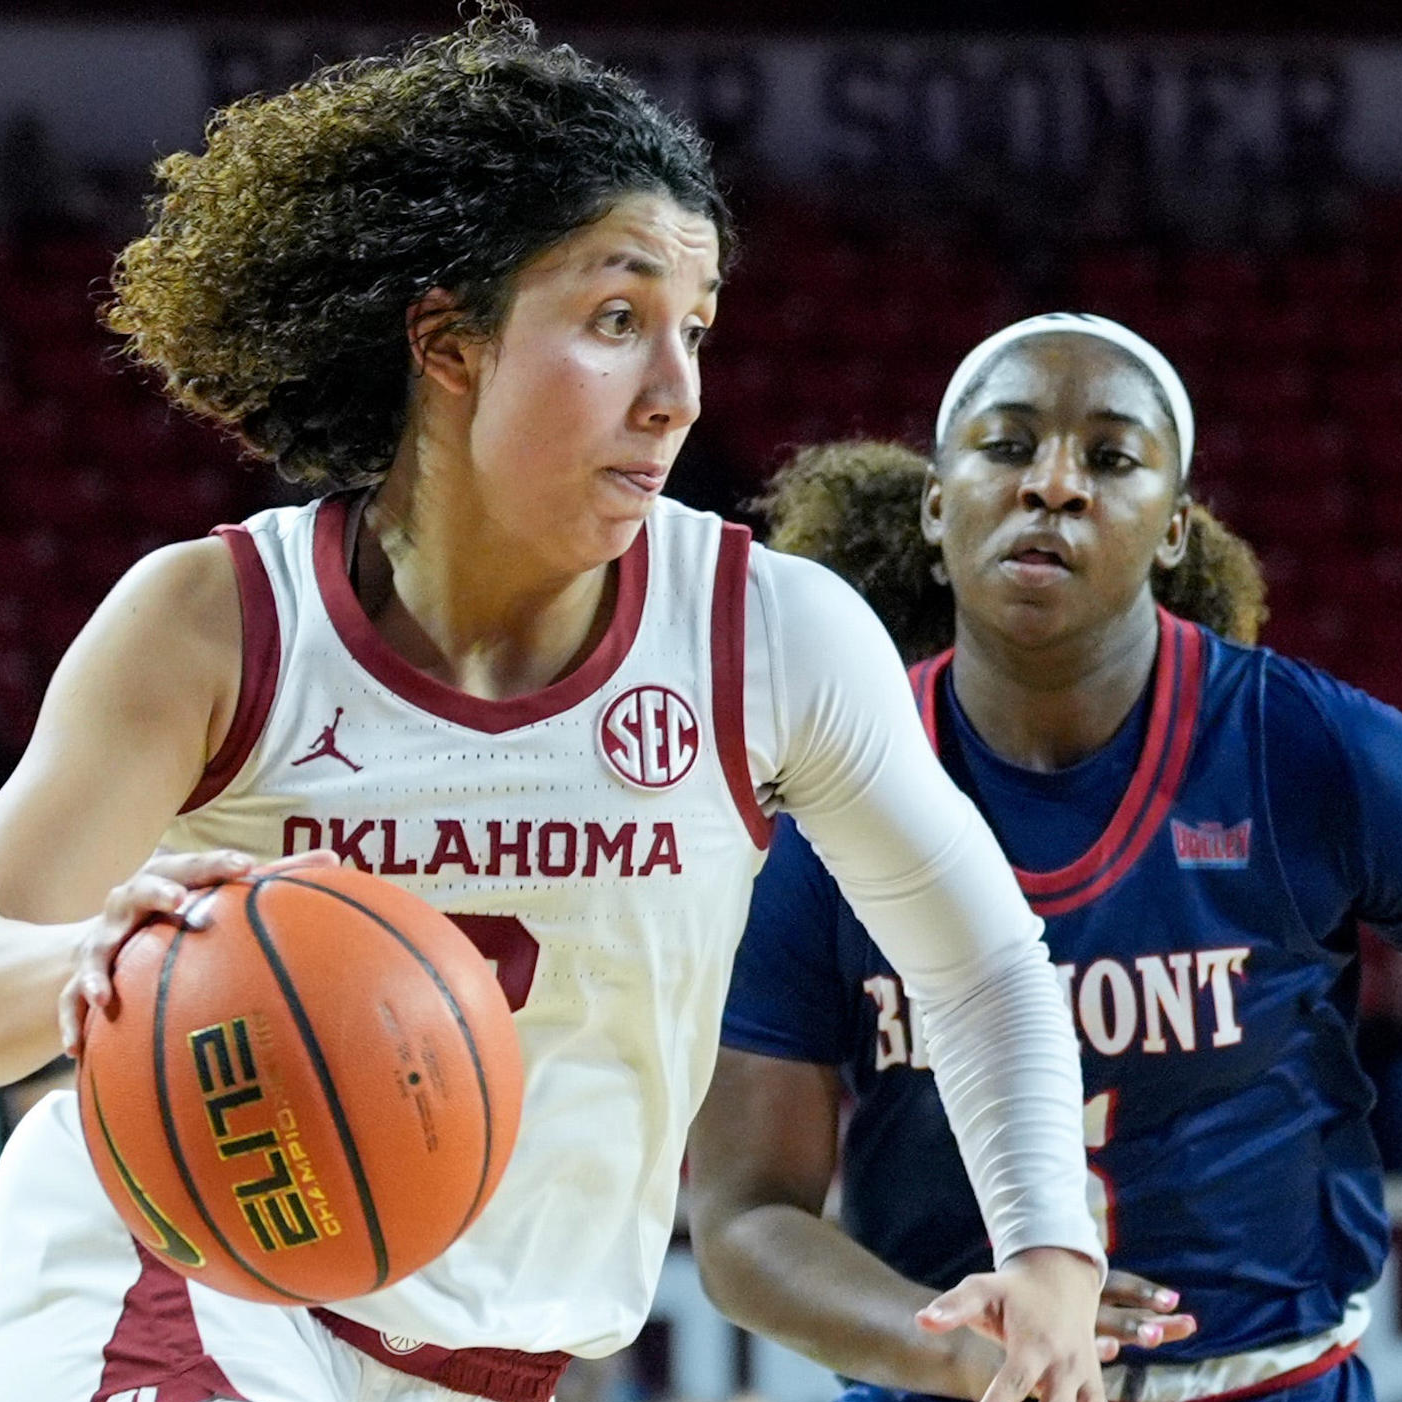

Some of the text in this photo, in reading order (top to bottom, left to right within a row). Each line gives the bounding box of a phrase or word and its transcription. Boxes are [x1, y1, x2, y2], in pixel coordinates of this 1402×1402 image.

[604, 687, 697, 784] SEC
[282, 815, 683, 878] OKLAHOMA
[187, 1016, 324, 1254] ELITE
